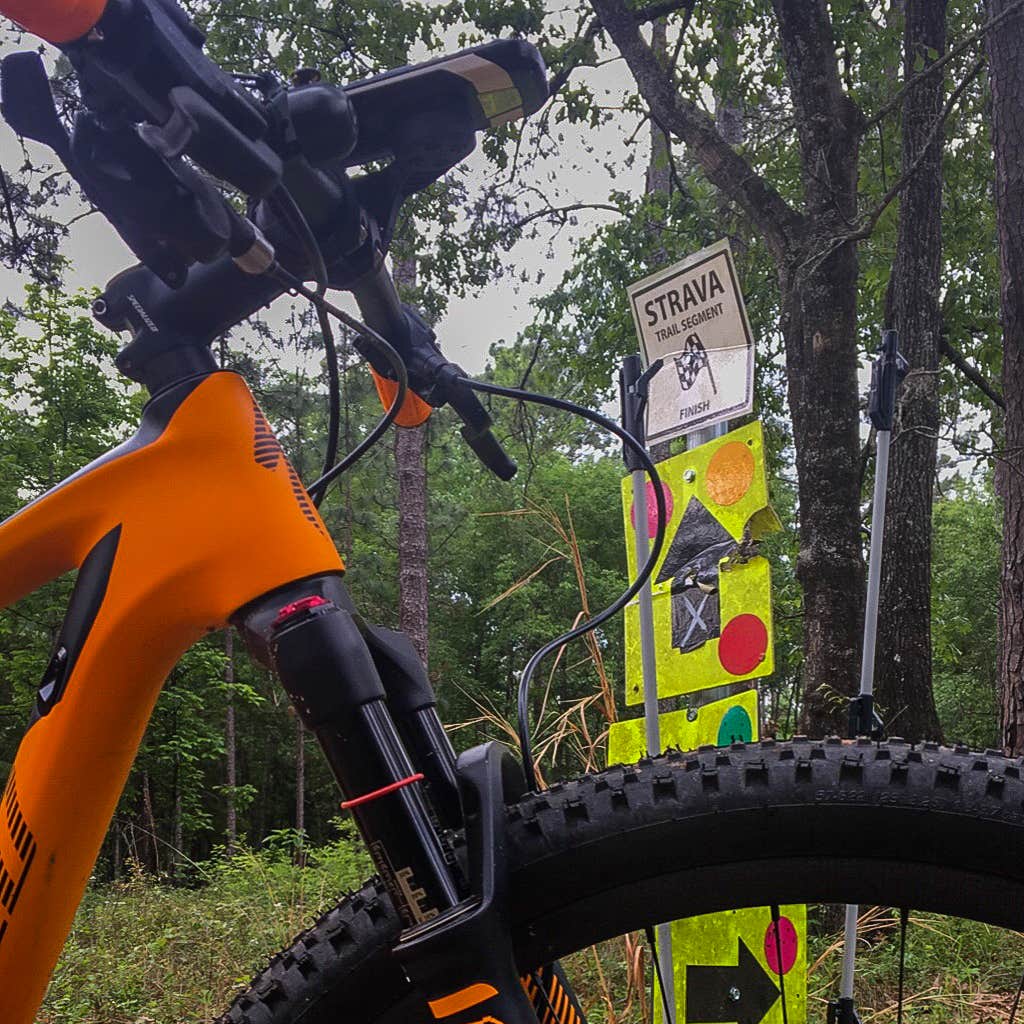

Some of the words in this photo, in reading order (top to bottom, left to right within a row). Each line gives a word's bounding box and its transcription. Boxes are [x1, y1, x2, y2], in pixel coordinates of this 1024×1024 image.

[645, 270, 725, 327] STRAVA
[655, 324, 681, 342] TRAIL
[681, 303, 724, 331] SEGMENT
[679, 400, 710, 420] FINISH
